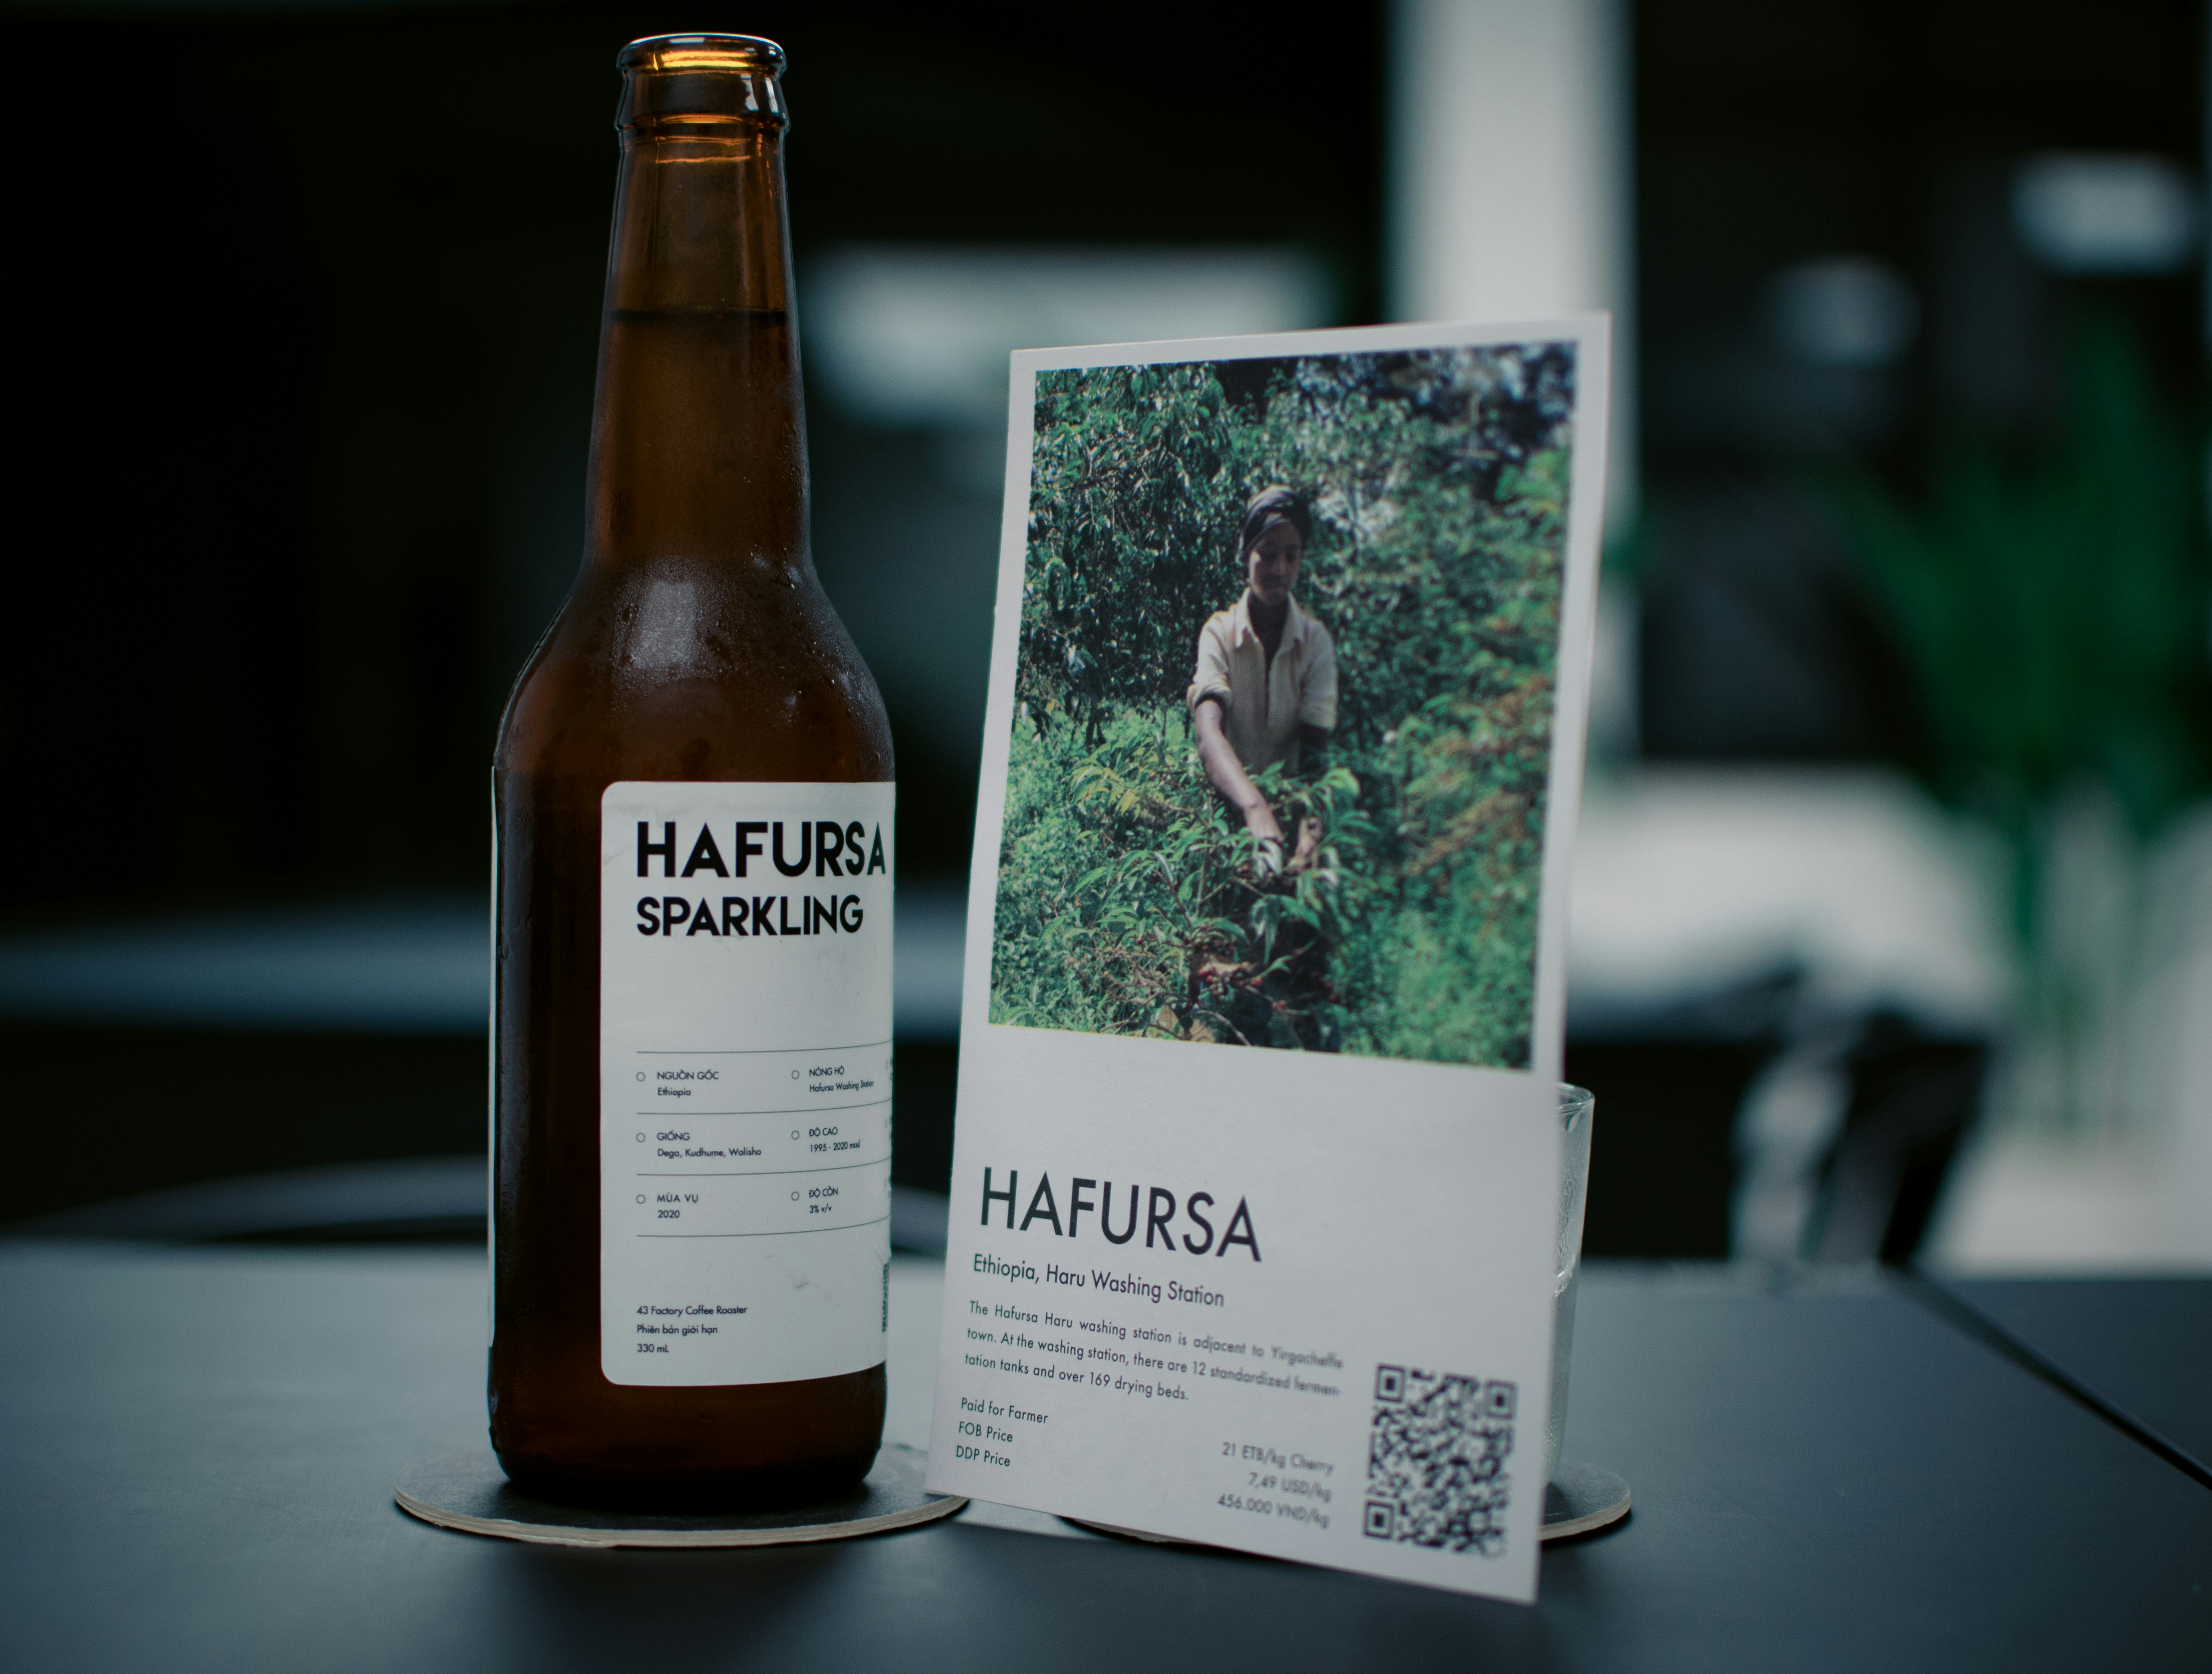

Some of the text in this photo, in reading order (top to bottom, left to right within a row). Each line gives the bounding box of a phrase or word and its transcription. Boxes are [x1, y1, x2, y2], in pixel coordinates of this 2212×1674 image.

[637, 821, 886, 878] HAFURSA
[637, 894, 863, 936] SPARKLING
[657, 1069, 719, 1080] NGUỒN GỐC
[809, 1065, 845, 1076] NÔNG HỘ
[809, 1080, 874, 1092] Hafursa Washing Station
[658, 1087, 691, 1098] Ethiopia
[657, 1130, 690, 1141] GIỐNG
[809, 1127, 838, 1137] ĐỘ CAO
[810, 1143, 827, 1152] 1995
[833, 1141, 848, 1151] 2020
[849, 1140, 861, 1148] masl
[658, 1147, 762, 1159] Dega, Kudhume, Wolisho
[657, 1193, 699, 1204] MÙA VỤ
[809, 1186, 838, 1199] ĐỘ CỒN
[658, 1209, 680, 1218] 2020
[809, 1203, 832, 1214] 3% v/v
[981, 1166, 1262, 1262] HAFURSA
[974, 1253, 1224, 1306] Ethiopia, Haru Washing Station
[637, 1305, 748, 1317] 43 Factory Coffee Roaster
[637, 1324, 718, 1336] Phiên bản giới hạn
[970, 1300, 988, 1315] The
[995, 1304, 1038, 1323] Hafursa
[1045, 1312, 1072, 1328] Haru
[1079, 1320, 1126, 1340] washing
[1133, 1327, 1172, 1343] station
[1178, 1332, 1187, 1345] is
[1193, 1335, 1246, 1354] adjacent
[1251, 1345, 1264, 1358] to
[637, 1343, 669, 1353] 330 mL
[968, 1328, 996, 1343] town.
[1001, 1332, 1014, 1345] At
[1017, 1333, 1034, 1348] the
[1038, 1340, 1084, 1360] washing
[1088, 1348, 1129, 1366] station,
[1134, 1352, 1164, 1369] there
[1168, 1362, 1187, 1373] are
[1193, 1361, 1206, 1376] 12
[1210, 1367, 1291, 1389] standardized
[965, 1353, 1188, 1400] tation tanks and over 169 drying beds.
[961, 1397, 1048, 1423] Paid for Farmer
[958, 1421, 1013, 1442] FOB Price
[956, 1445, 1010, 1466] DDP Price
[1222, 1442, 1236, 1456] 21
[1242, 1445, 1286, 1469] ETB/kg
[1281, 1478, 1332, 1503] USD/kg
